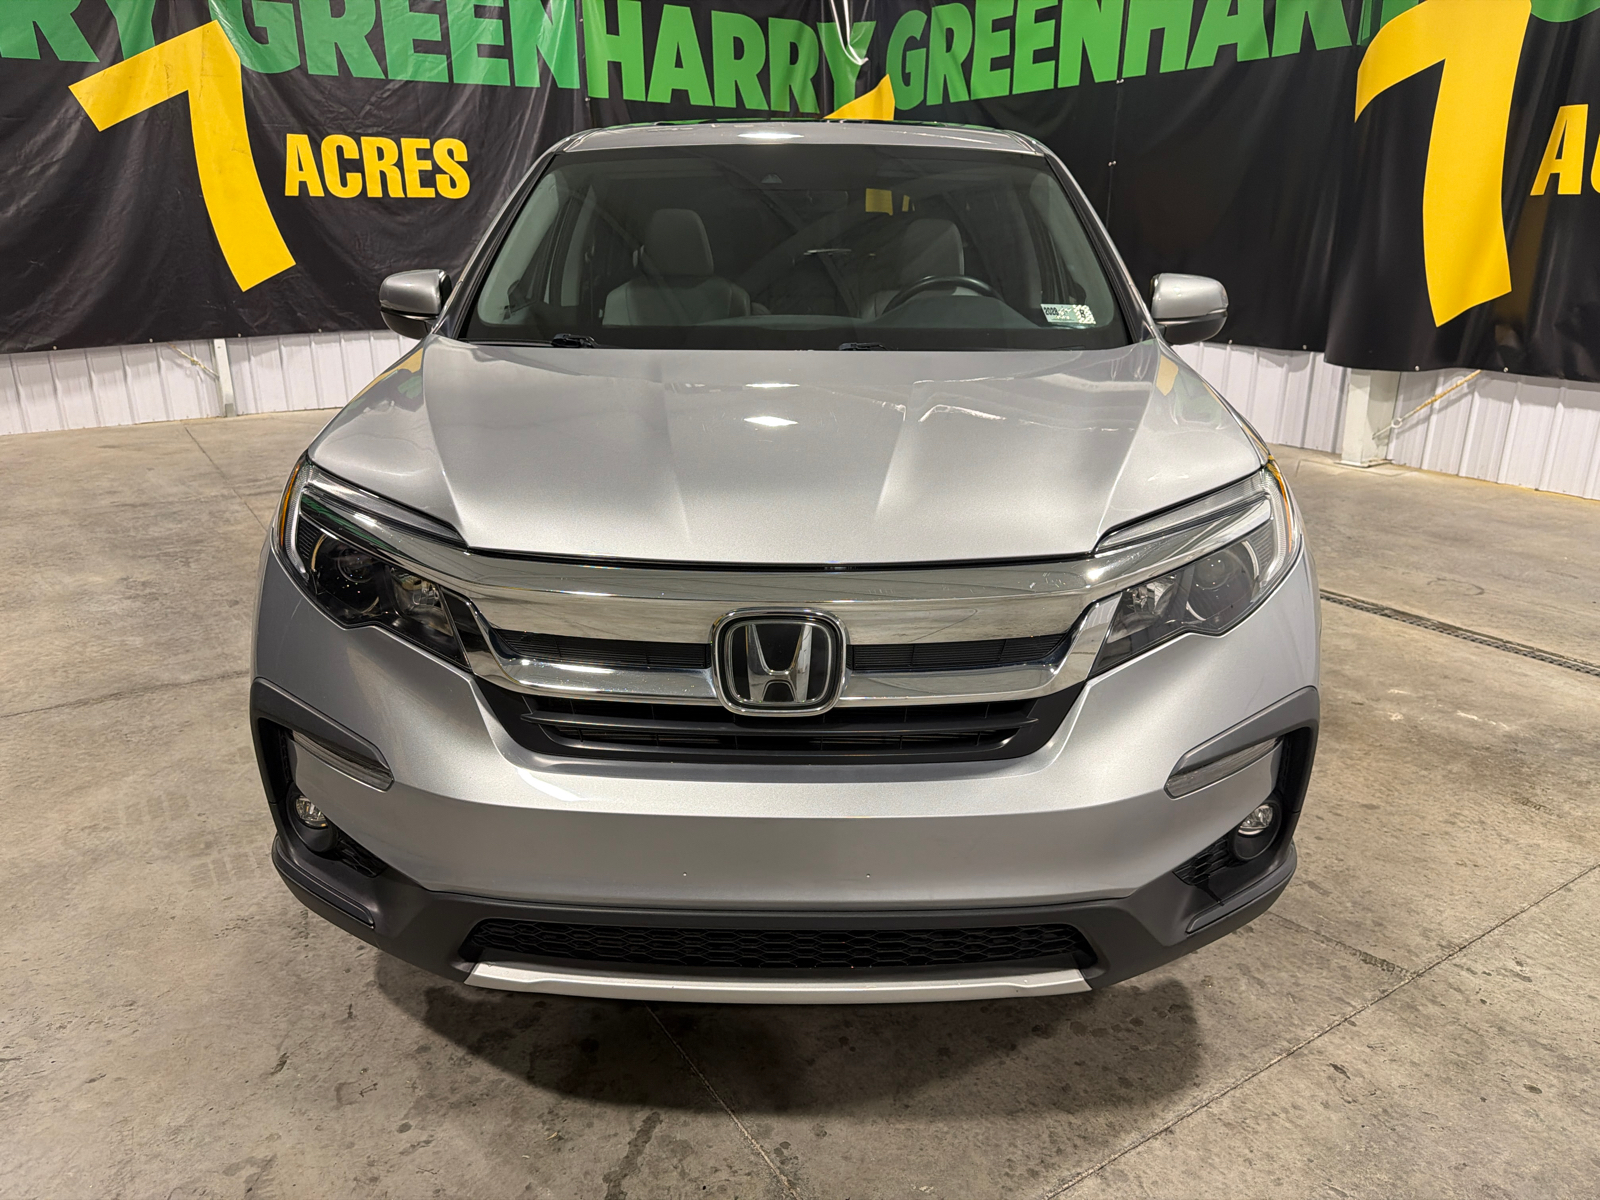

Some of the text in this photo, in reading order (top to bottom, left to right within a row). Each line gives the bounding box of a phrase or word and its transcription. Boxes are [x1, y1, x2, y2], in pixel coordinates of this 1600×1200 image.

[208, 0, 580, 89] GREEN
[582, 0, 877, 114] HARRY
[886, 0, 1125, 110] GREEN
[68, 19, 471, 292] 7 ACRES
[1354, 0, 1600, 328] 7 A
